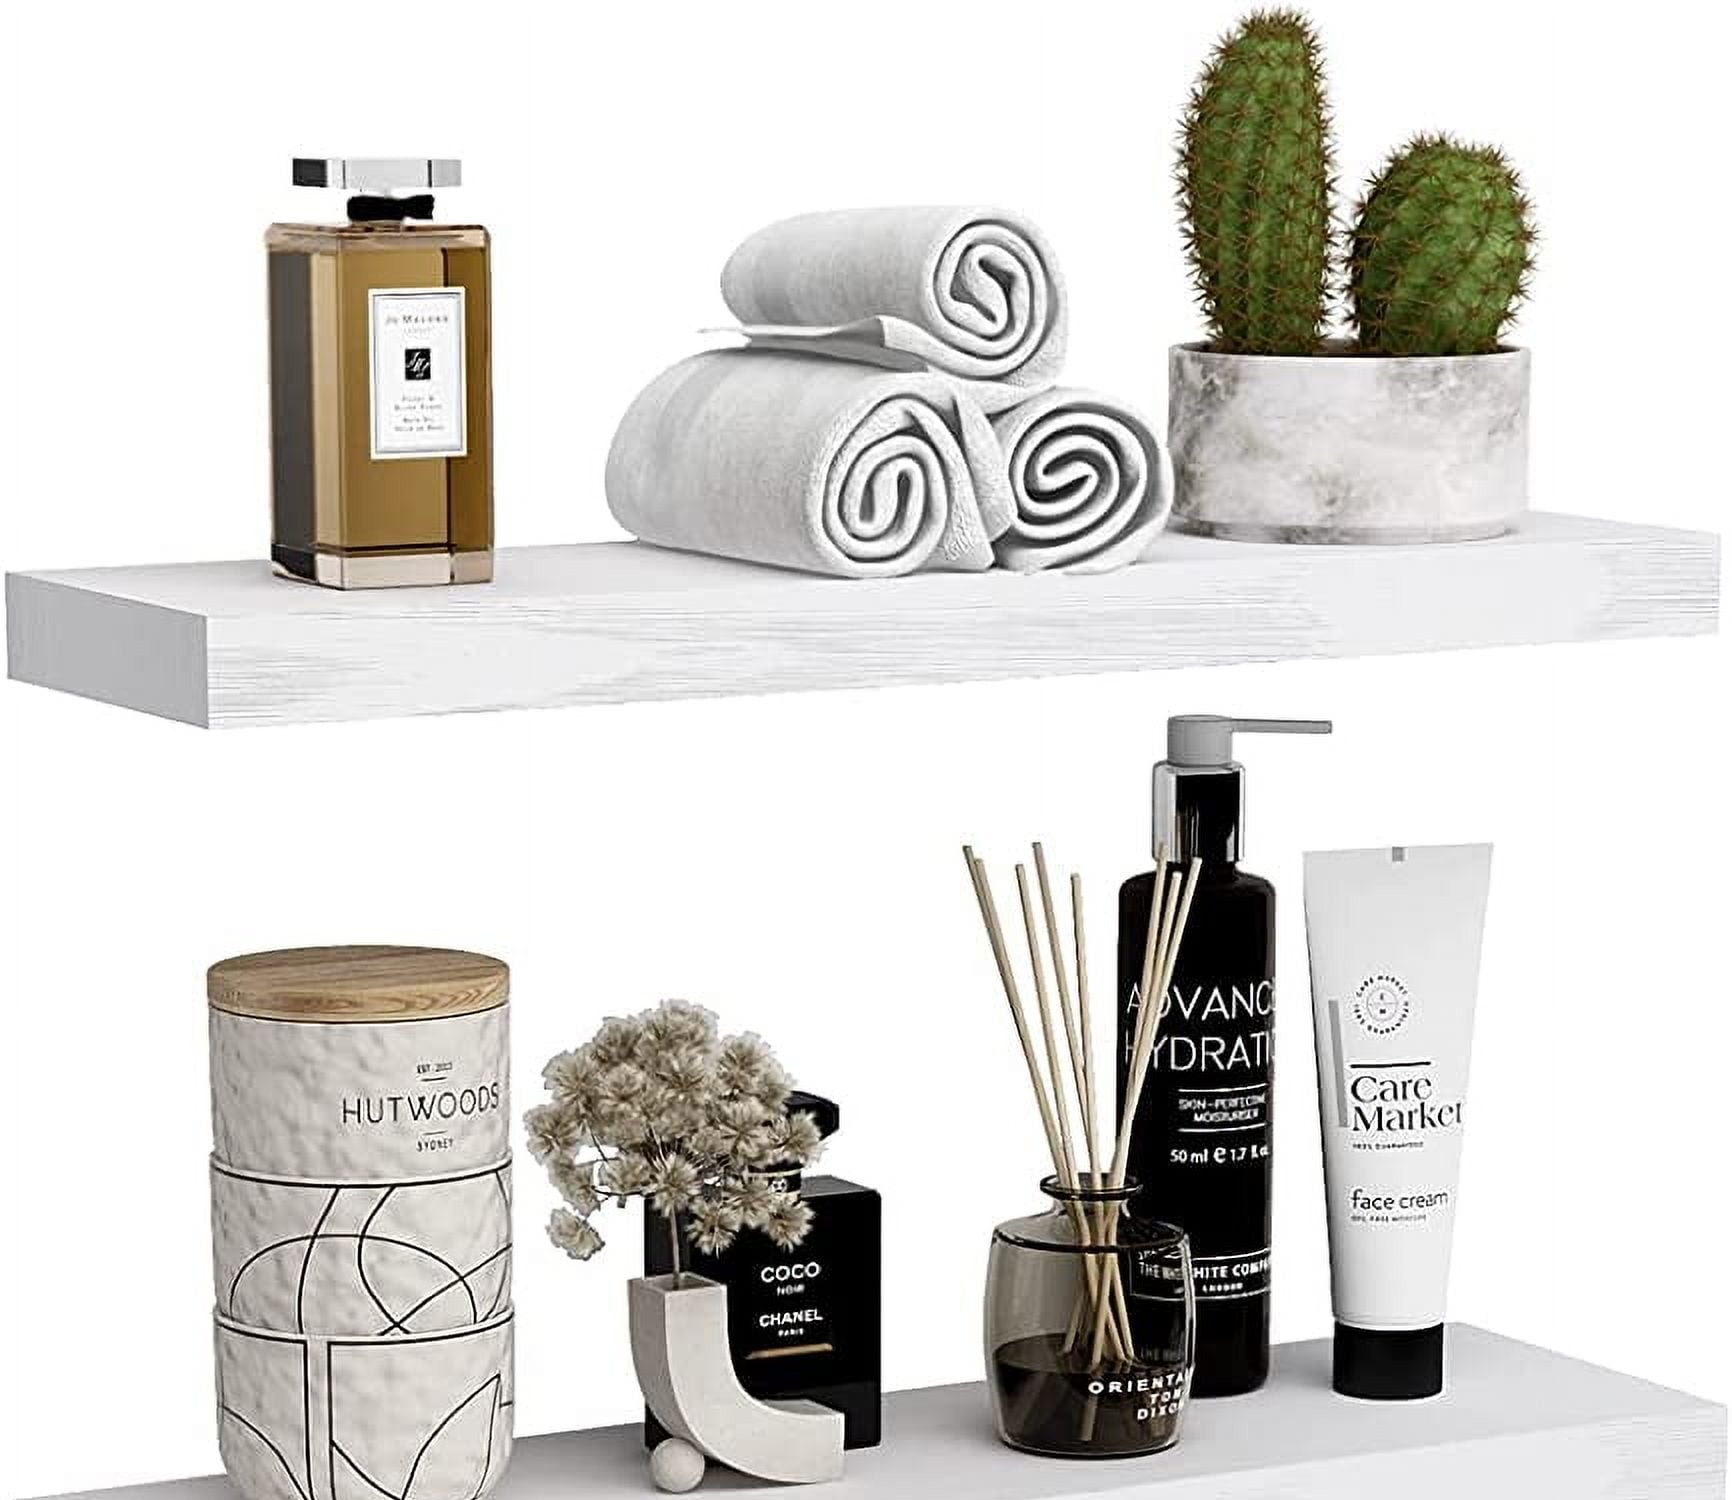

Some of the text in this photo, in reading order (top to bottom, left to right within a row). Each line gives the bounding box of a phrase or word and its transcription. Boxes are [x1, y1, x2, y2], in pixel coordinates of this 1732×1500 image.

[1351, 1075, 1432, 1103] Care
[342, 1082, 499, 1124] HUTWOODS
[1352, 1101, 1462, 1132] Market
[1170, 1148, 1188, 1164] 50
[1190, 1147, 1209, 1164] ml
[1350, 1187, 1448, 1210] face cream
[760, 1261, 822, 1283] COCO
[1192, 1265, 1229, 1279] HITE
[758, 1308, 824, 1328] CHANEL
